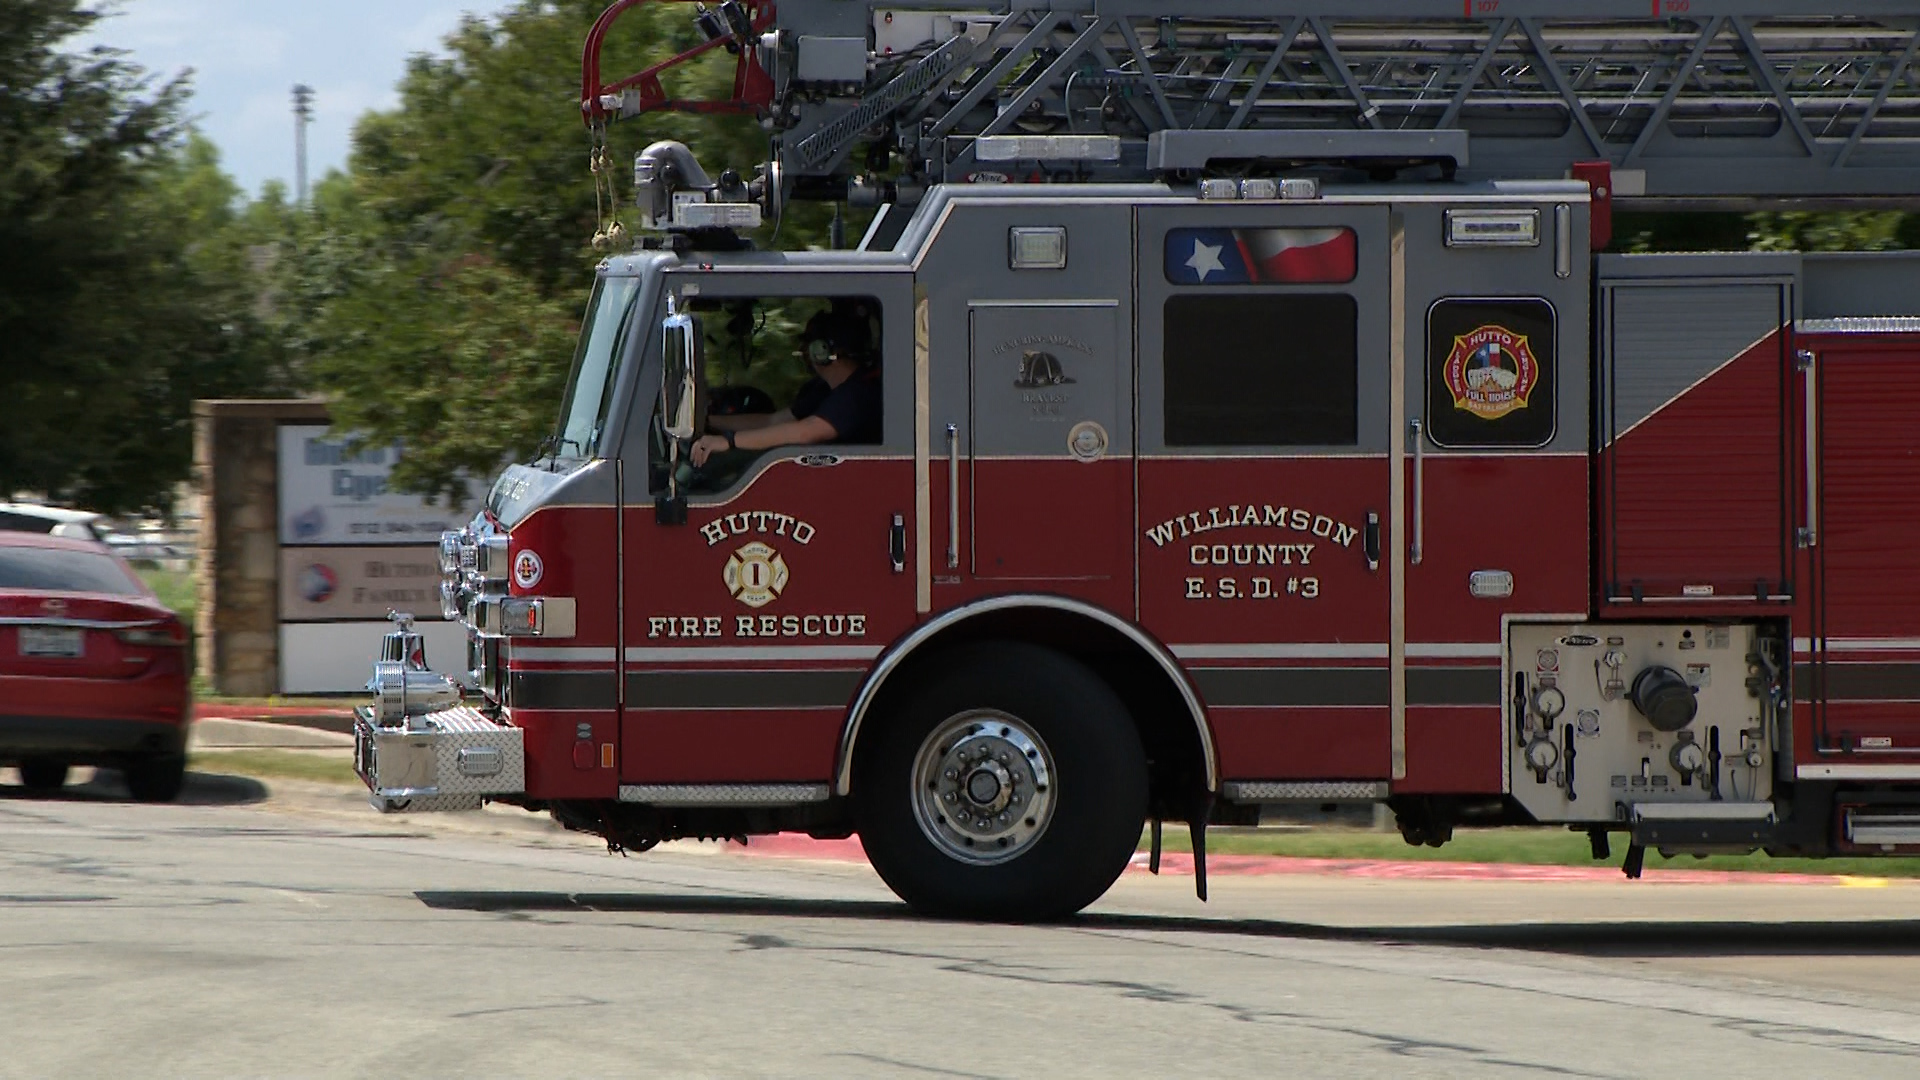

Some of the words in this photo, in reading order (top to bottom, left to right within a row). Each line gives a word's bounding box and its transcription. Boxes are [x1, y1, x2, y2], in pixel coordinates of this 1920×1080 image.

[1470, 331, 1512, 346] HUTTO
[1466, 390, 1486, 403] FULL
[1488, 389, 1516, 403] HOUSE
[699, 510, 816, 547] HUTTO
[1145, 504, 1359, 549] WILLIAMSON
[1190, 544, 1316, 565] COUNTY
[1287, 577, 1319, 598] #3
[648, 615, 722, 638] FIRE
[735, 614, 867, 637] RESCUE
